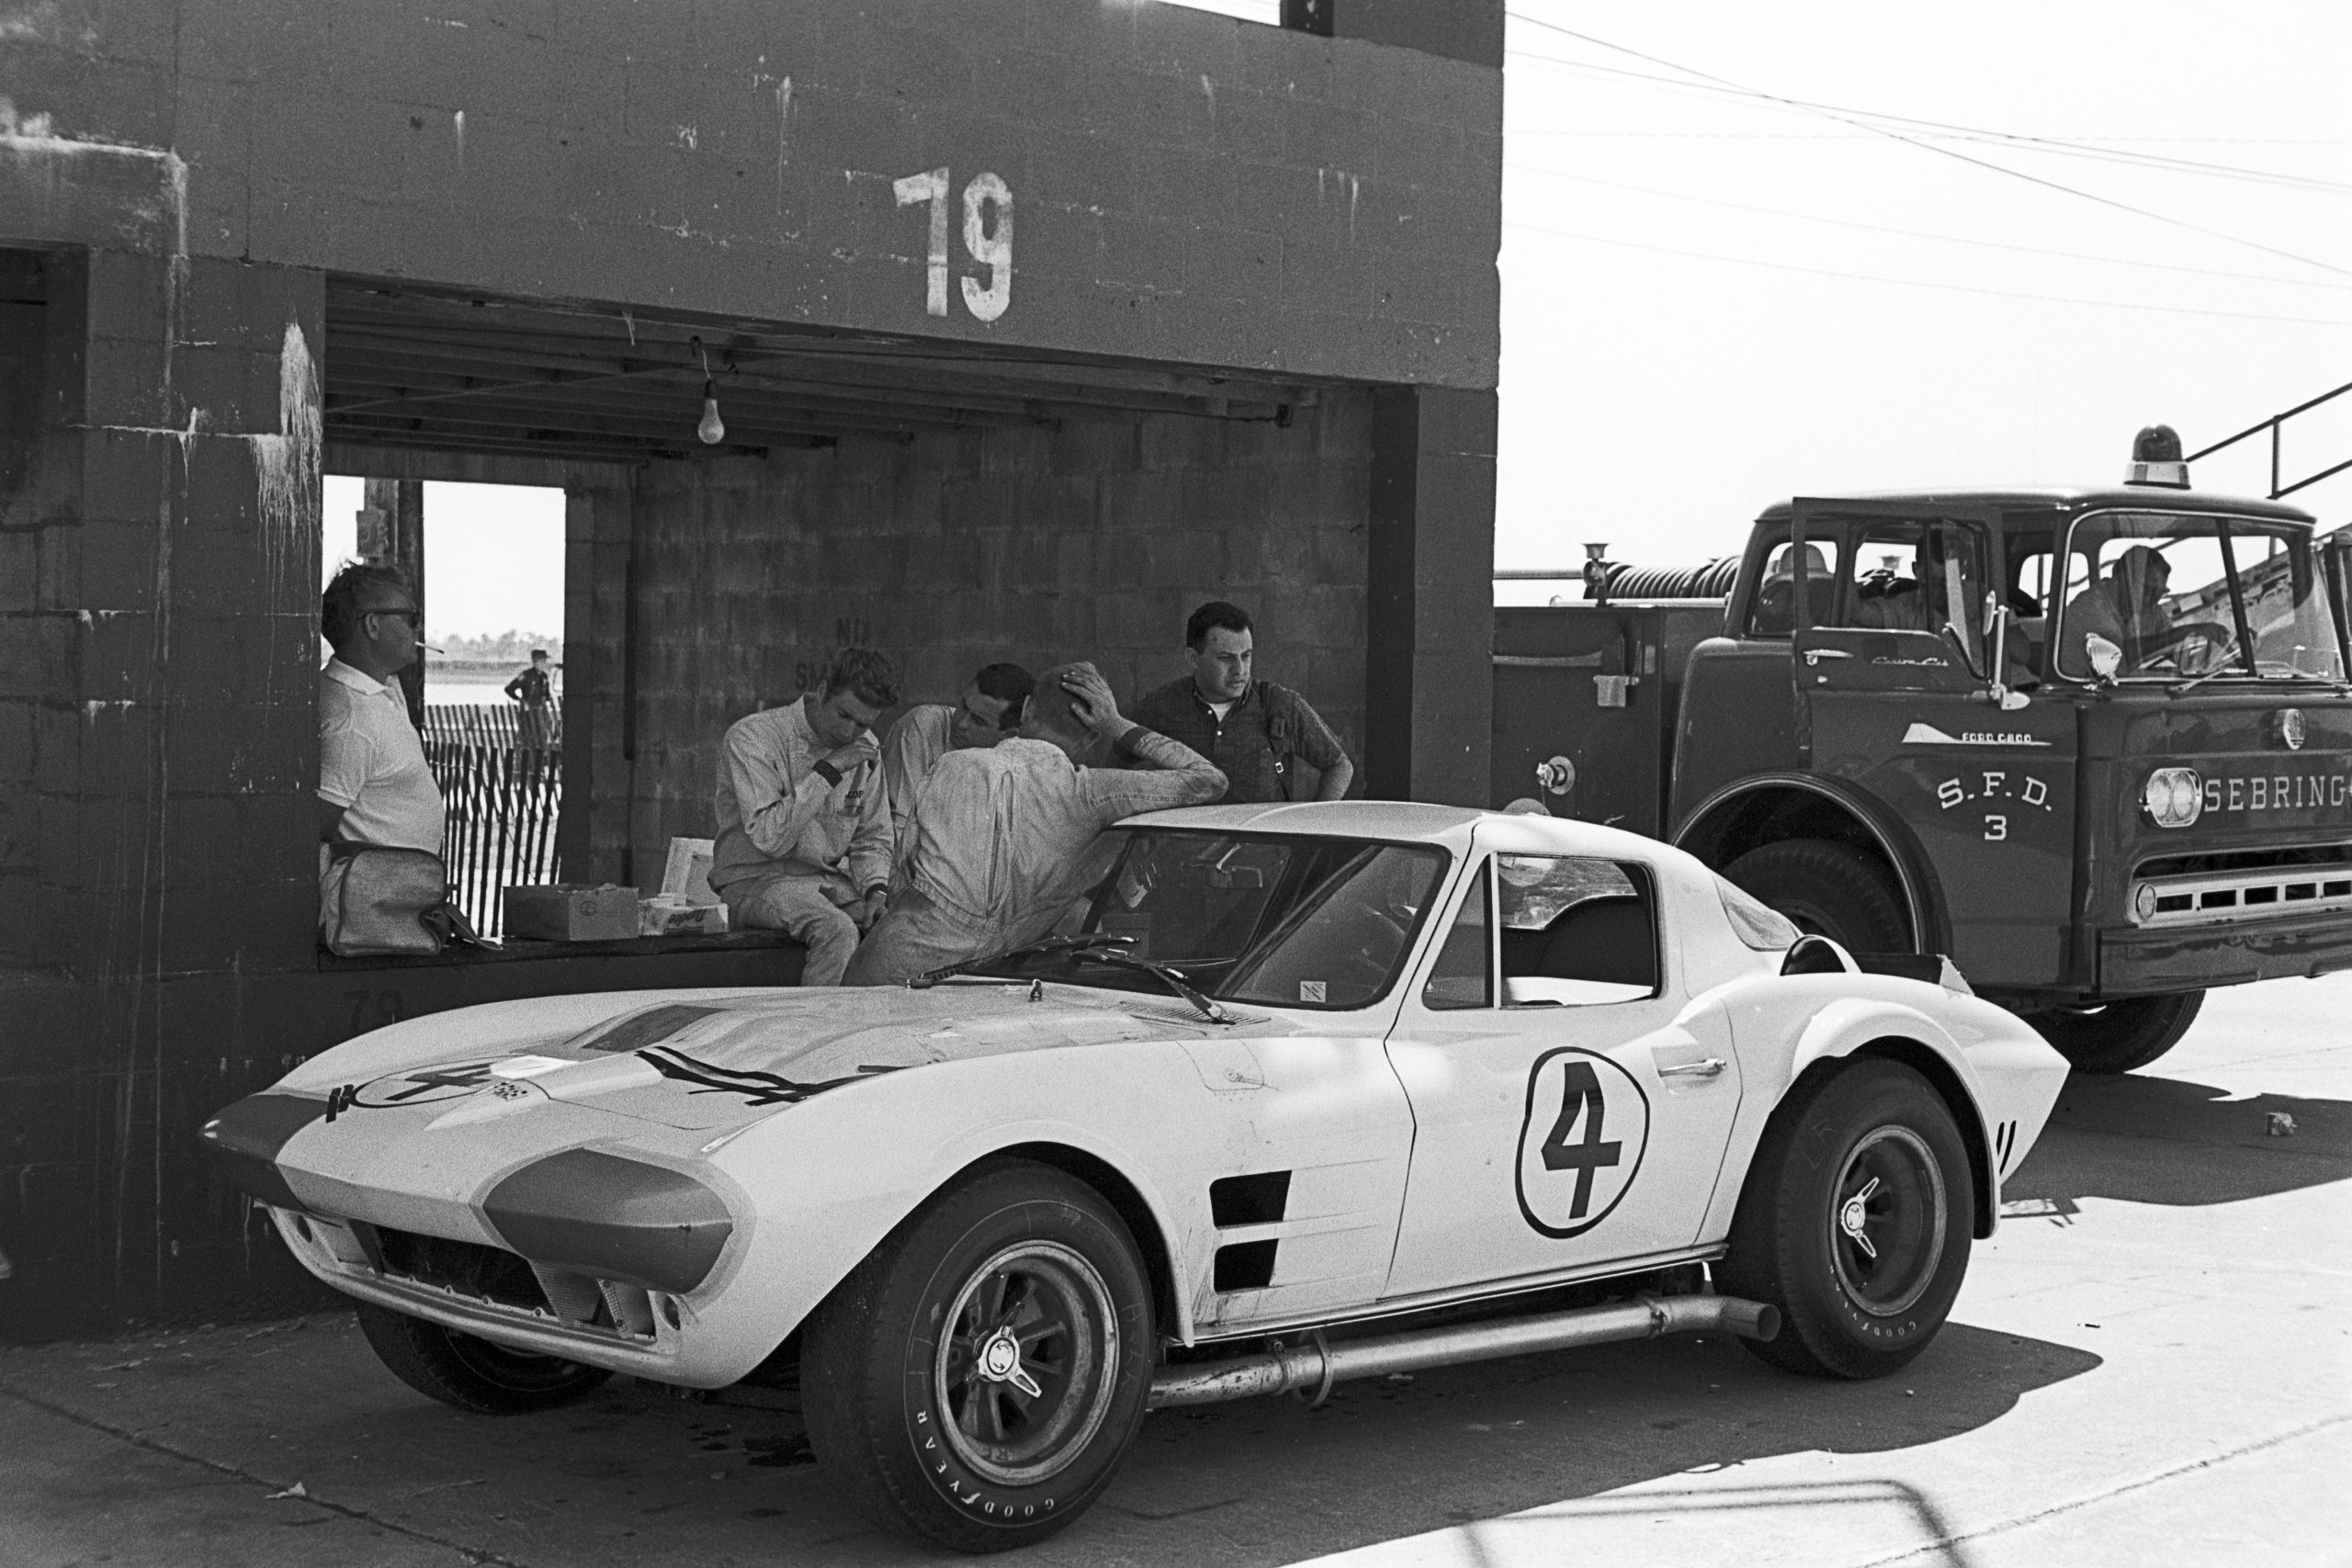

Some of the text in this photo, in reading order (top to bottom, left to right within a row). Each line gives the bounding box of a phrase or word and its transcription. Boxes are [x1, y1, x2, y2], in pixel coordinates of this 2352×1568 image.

[1984, 815, 2007, 840] 3
[2204, 775, 2346, 812] SEBRING
[1540, 1060, 1623, 1220] 4
[916, 1409, 1055, 1517] GOODYEAR
